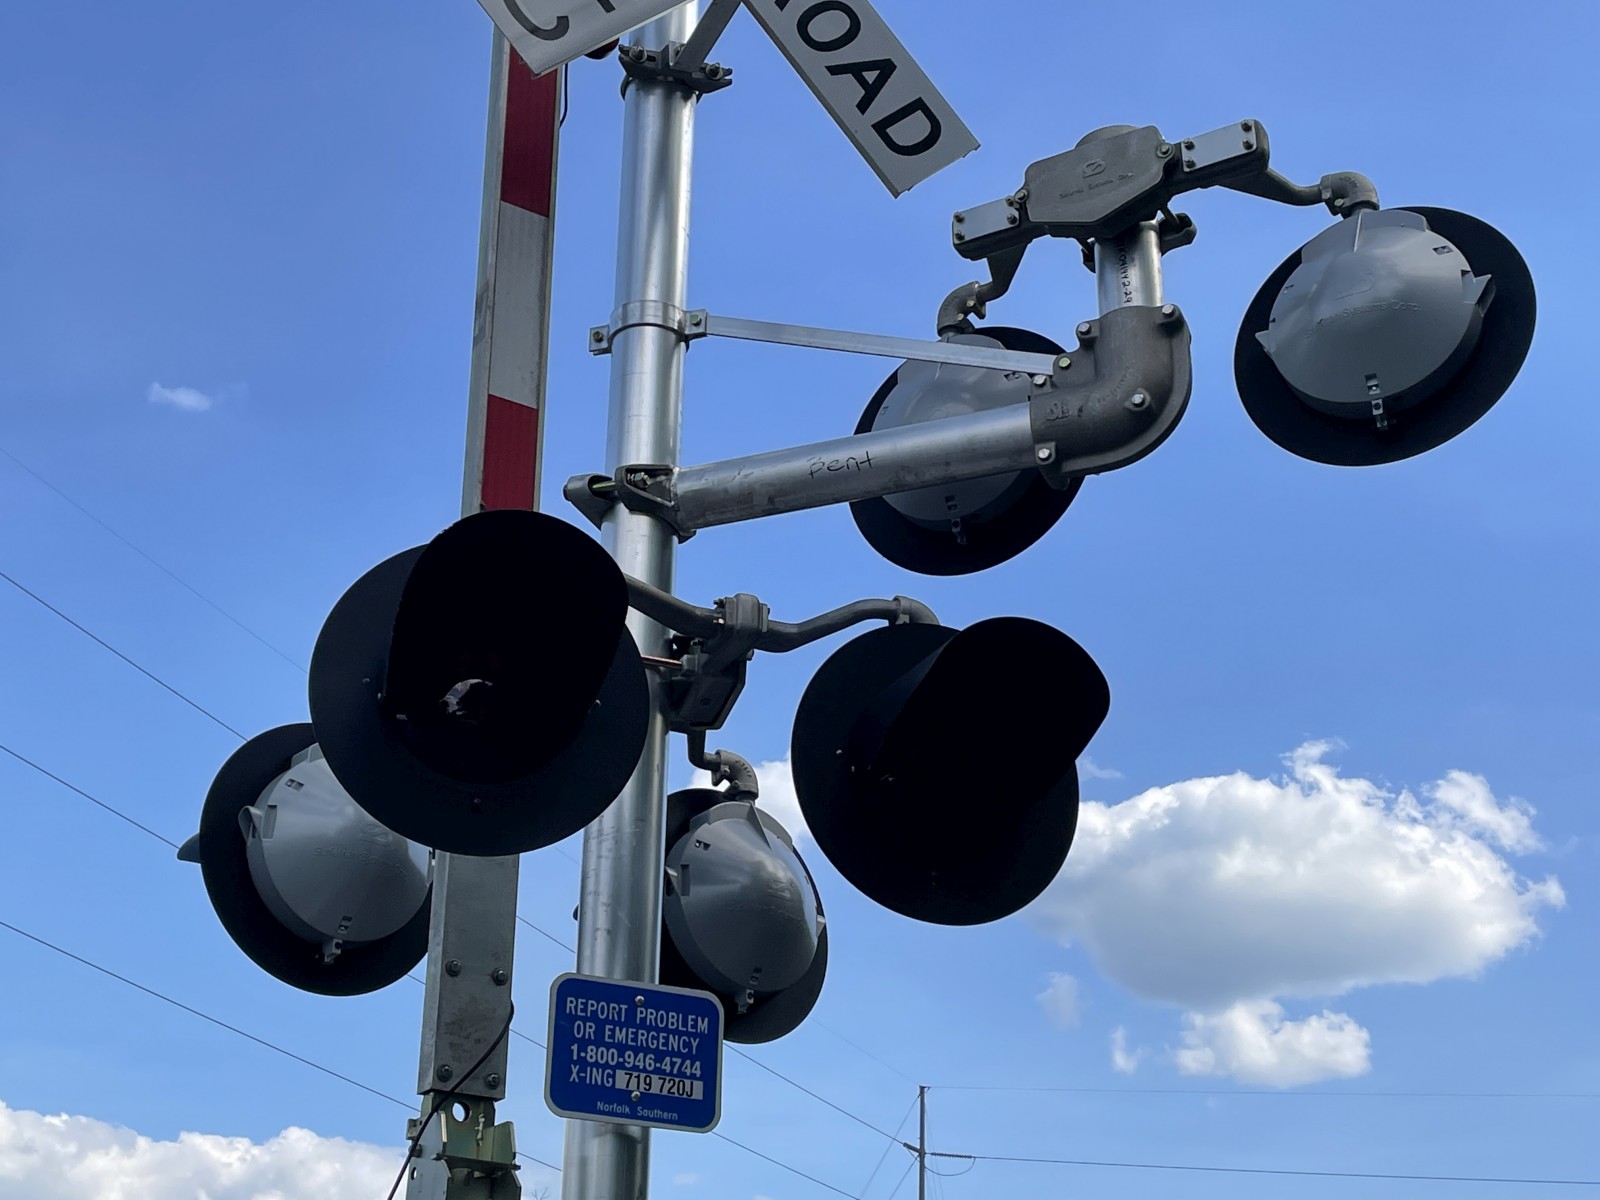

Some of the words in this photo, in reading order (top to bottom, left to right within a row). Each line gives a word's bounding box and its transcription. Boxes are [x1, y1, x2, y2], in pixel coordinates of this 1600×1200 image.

[775, 0, 942, 156] OAD
[566, 997, 628, 1022] REPORT
[636, 1007, 709, 1034] PROBLEM
[573, 1020, 596, 1040] OR
[604, 1025, 700, 1055] EMERGENCY
[570, 1043, 702, 1077] 1-800-946-4744
[569, 1064, 613, 1087] X-ING
[624, 1072, 653, 1092] 719
[658, 1076, 695, 1098] 720J
[597, 1101, 631, 1114] Norfolk
[636, 1106, 679, 1121] Southern
